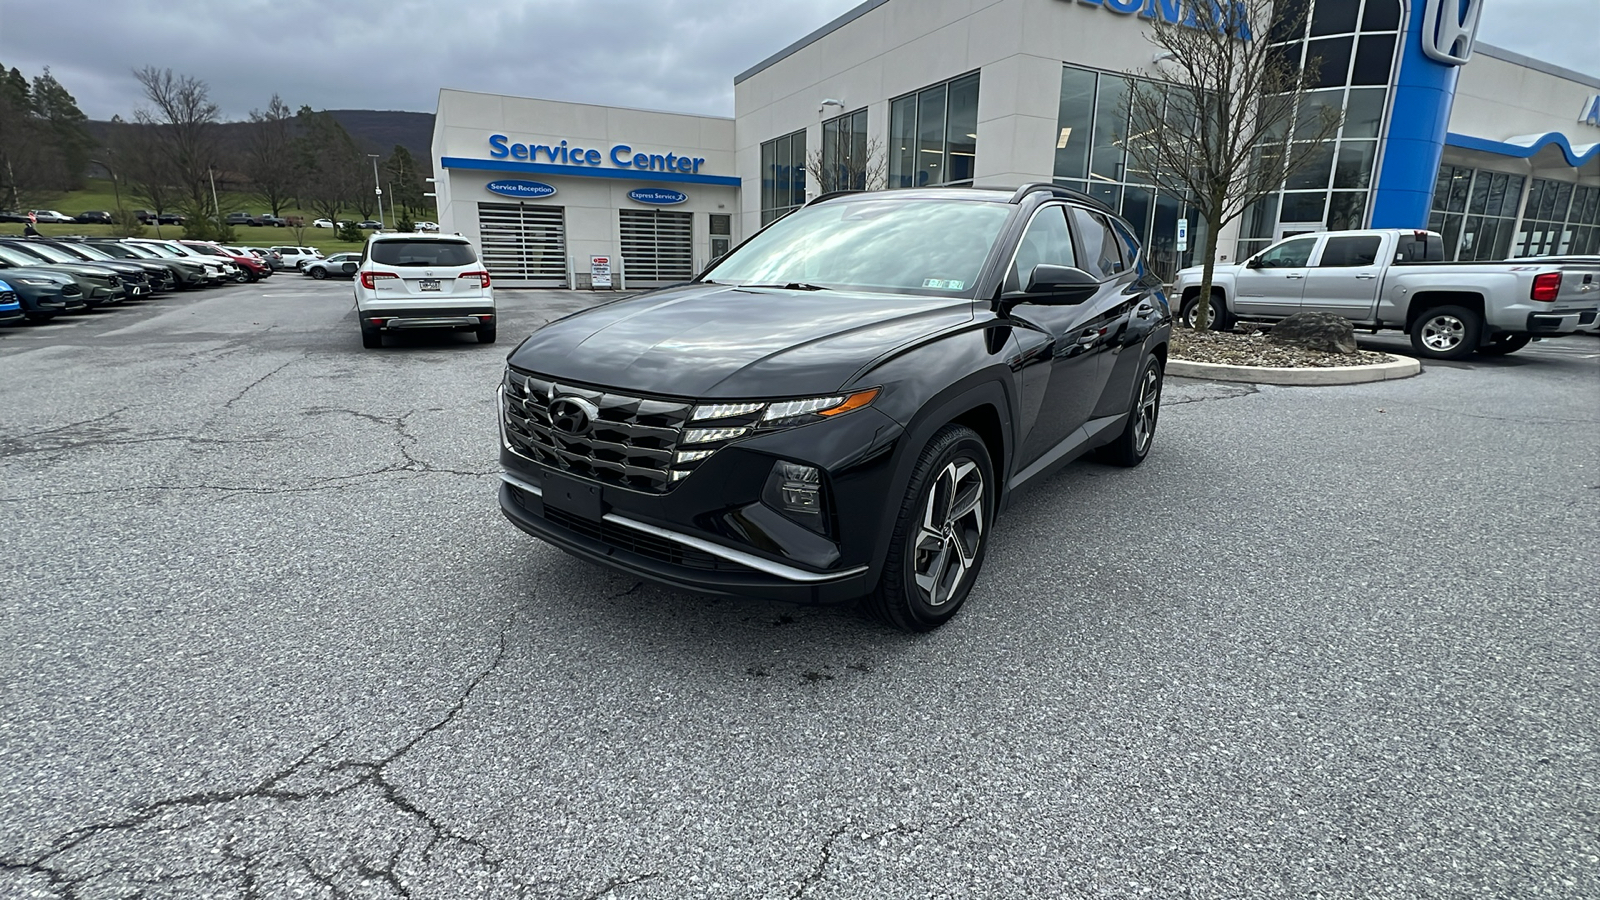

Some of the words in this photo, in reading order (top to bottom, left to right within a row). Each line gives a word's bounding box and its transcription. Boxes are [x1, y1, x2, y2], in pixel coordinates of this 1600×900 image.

[488, 134, 602, 165] Service
[610, 145, 705, 174] Center
[490, 183, 517, 191] Service
[518, 184, 552, 193] Reception
[631, 191, 654, 199] Express
[654, 192, 675, 200] Service
